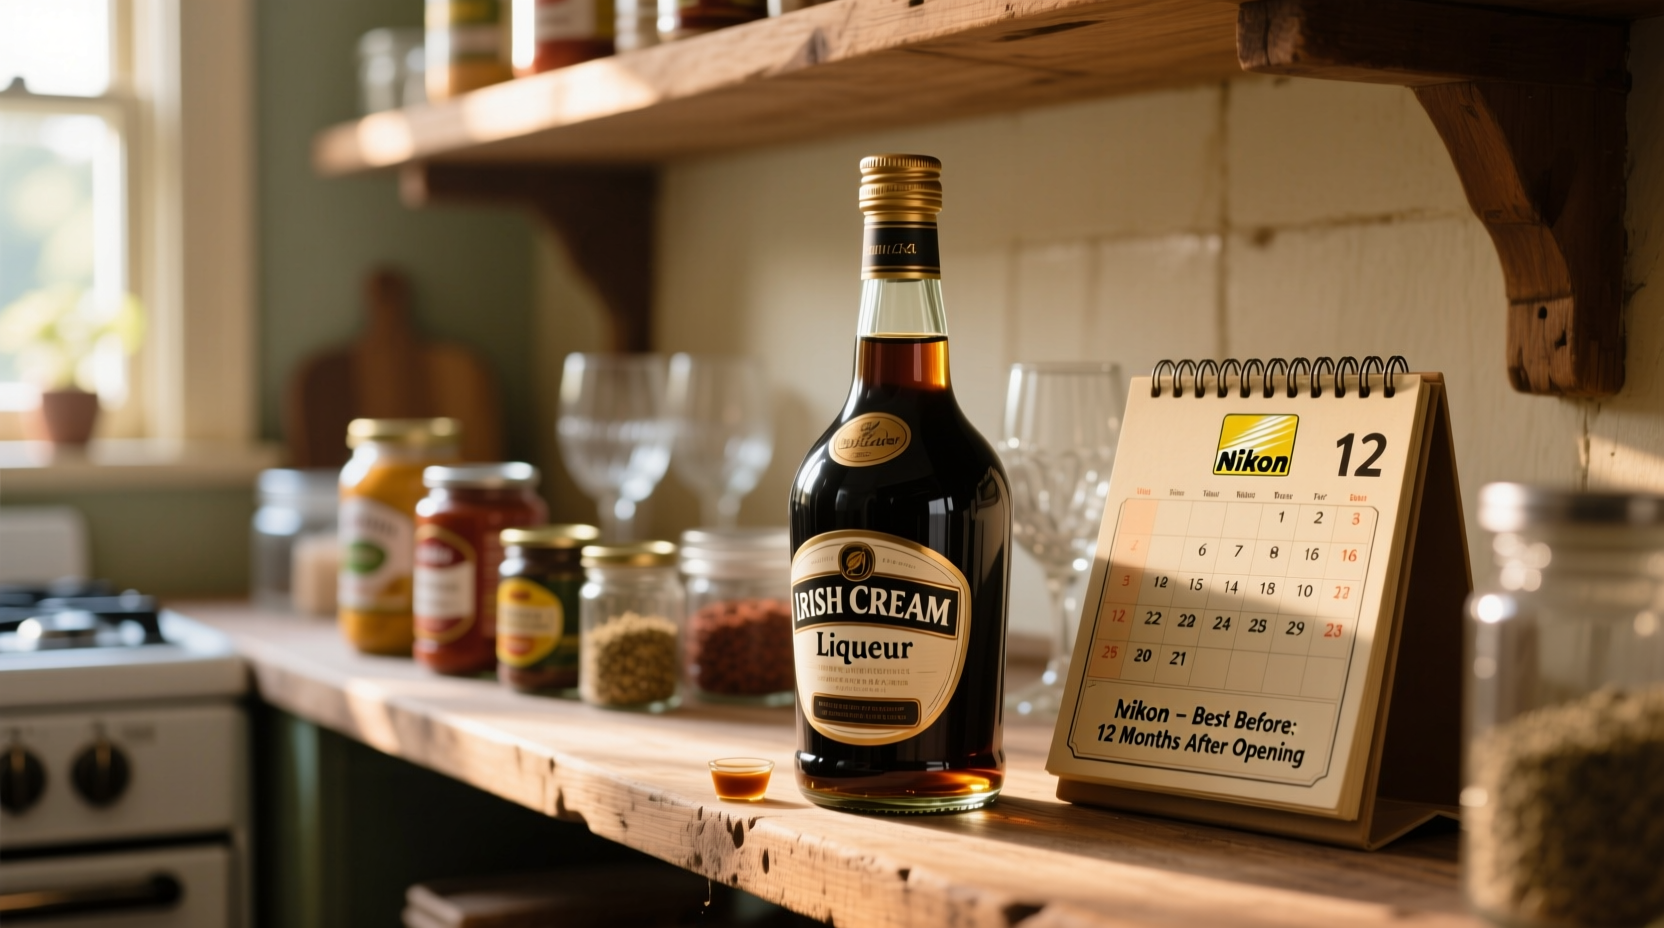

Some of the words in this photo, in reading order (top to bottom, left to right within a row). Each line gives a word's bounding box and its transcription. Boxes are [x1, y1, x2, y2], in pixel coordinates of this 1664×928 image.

[1216, 449, 1289, 473] Nikon
[1336, 432, 1387, 478] 12
[1278, 510, 1285, 524] 1
[1313, 511, 1324, 524] 2
[1351, 512, 1361, 526] 3
[1198, 543, 1207, 557] 6
[1234, 545, 1244, 558] 7
[1269, 545, 1279, 559] 8
[1305, 547, 1320, 561] 16
[1341, 548, 1358, 562] 16
[1189, 578, 1204, 591] 15
[1224, 580, 1239, 595] 14
[1260, 582, 1276, 595] 18
[1297, 584, 1313, 598] 10
[795, 586, 843, 622] IRISH
[849, 585, 951, 627] CREAM
[1112, 609, 1126, 623] 12
[1144, 611, 1162, 625] 22
[1212, 616, 1231, 631] 24
[1285, 621, 1305, 636] 29
[1324, 623, 1343, 638] 23
[816, 631, 914, 665] Liqueur
[1134, 648, 1152, 663] 20
[1169, 651, 1187, 666] 21
[1114, 699, 1170, 723] Nikon
[1191, 706, 1231, 728] Best
[1234, 710, 1297, 735] Before:
[1097, 723, 1115, 743] 12
[1118, 727, 1181, 750] Months
[1184, 733, 1228, 755] After
[1232, 738, 1305, 768] Opening
